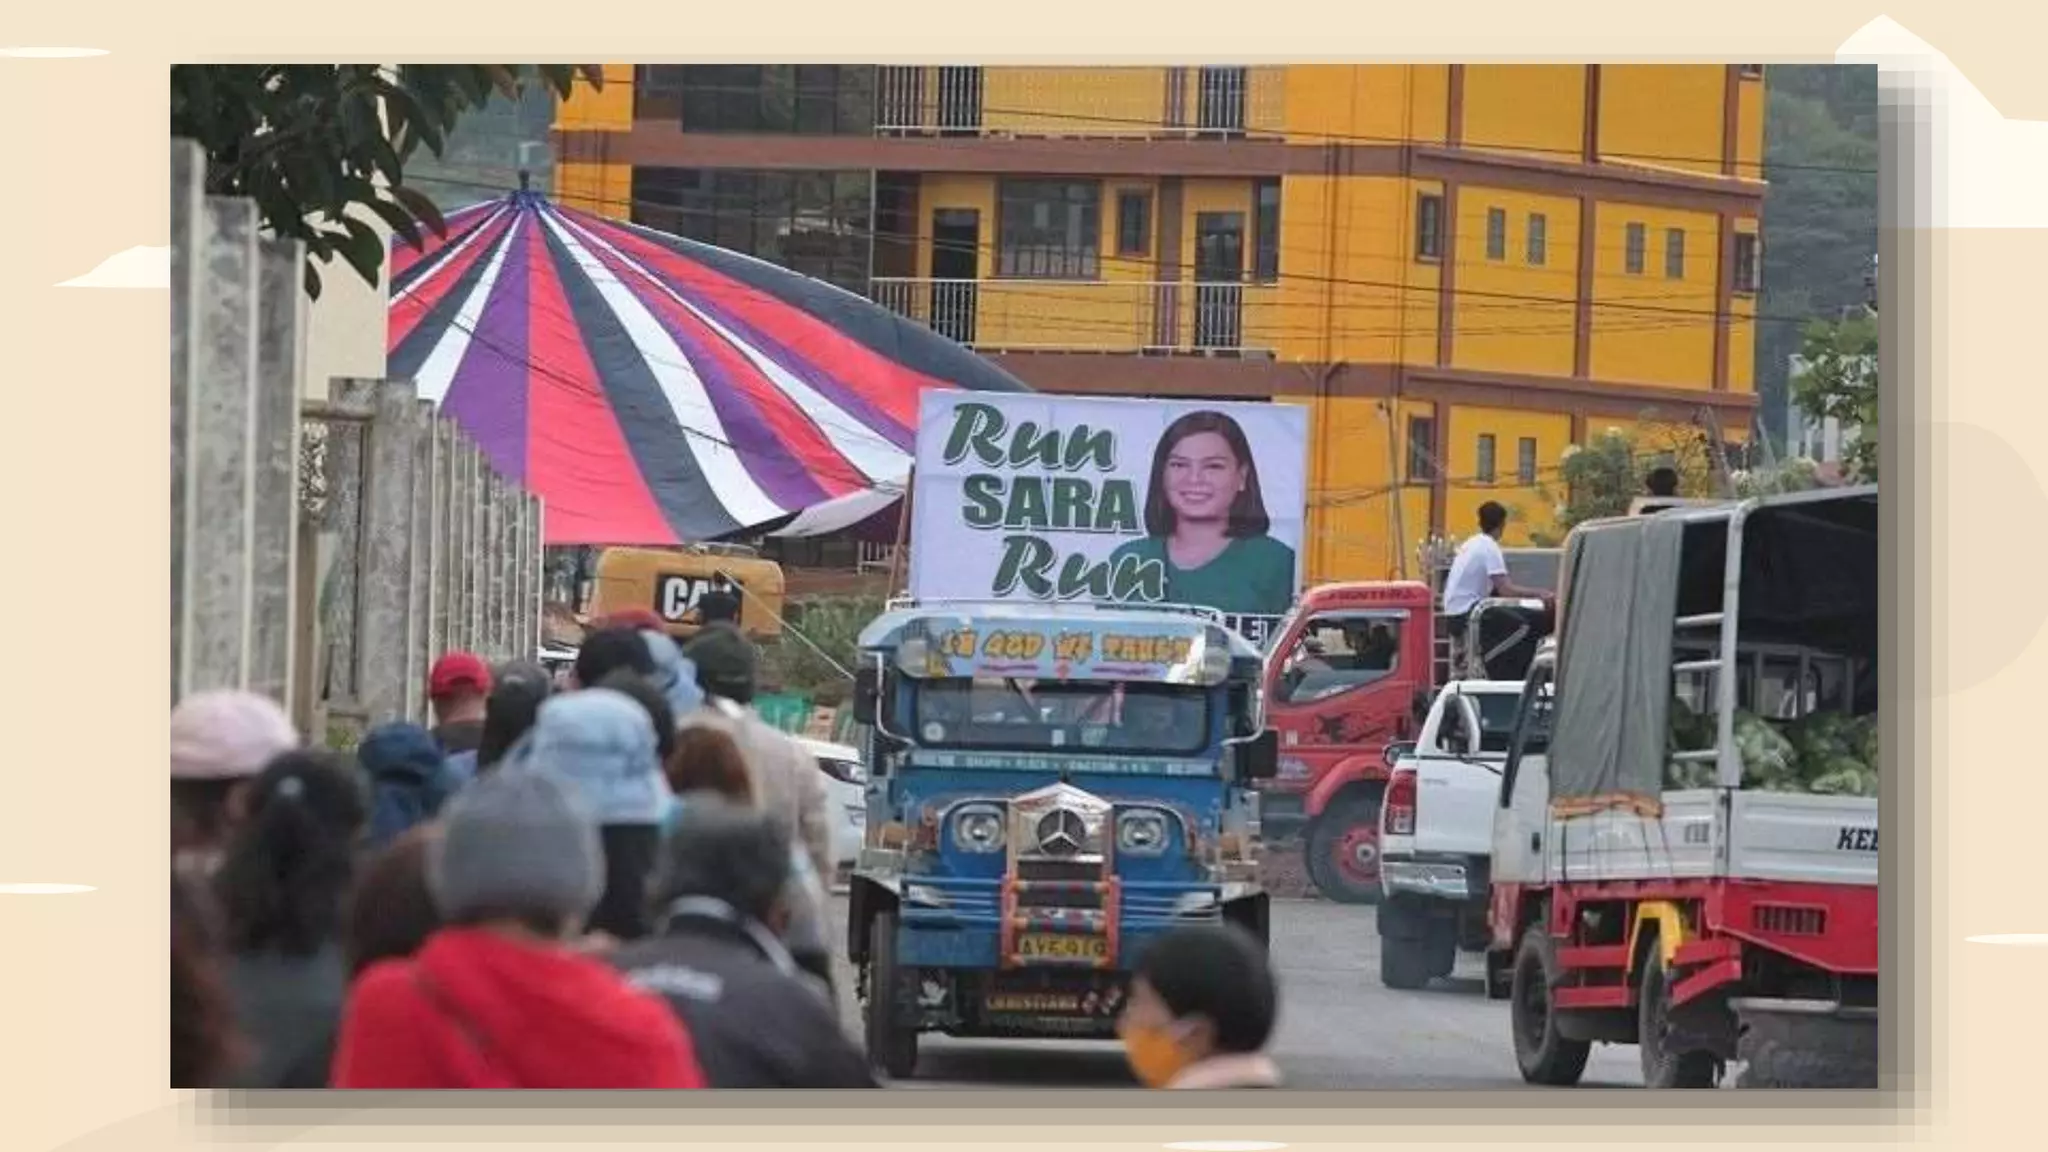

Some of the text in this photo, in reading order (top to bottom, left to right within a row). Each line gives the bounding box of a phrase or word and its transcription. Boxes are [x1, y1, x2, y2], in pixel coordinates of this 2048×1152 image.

[943, 402, 1116, 472] Run
[962, 474, 1143, 534] SARA
[992, 536, 1164, 601] Run
[982, 630, 1045, 660] GOD
[1102, 633, 1193, 662] TRUST
